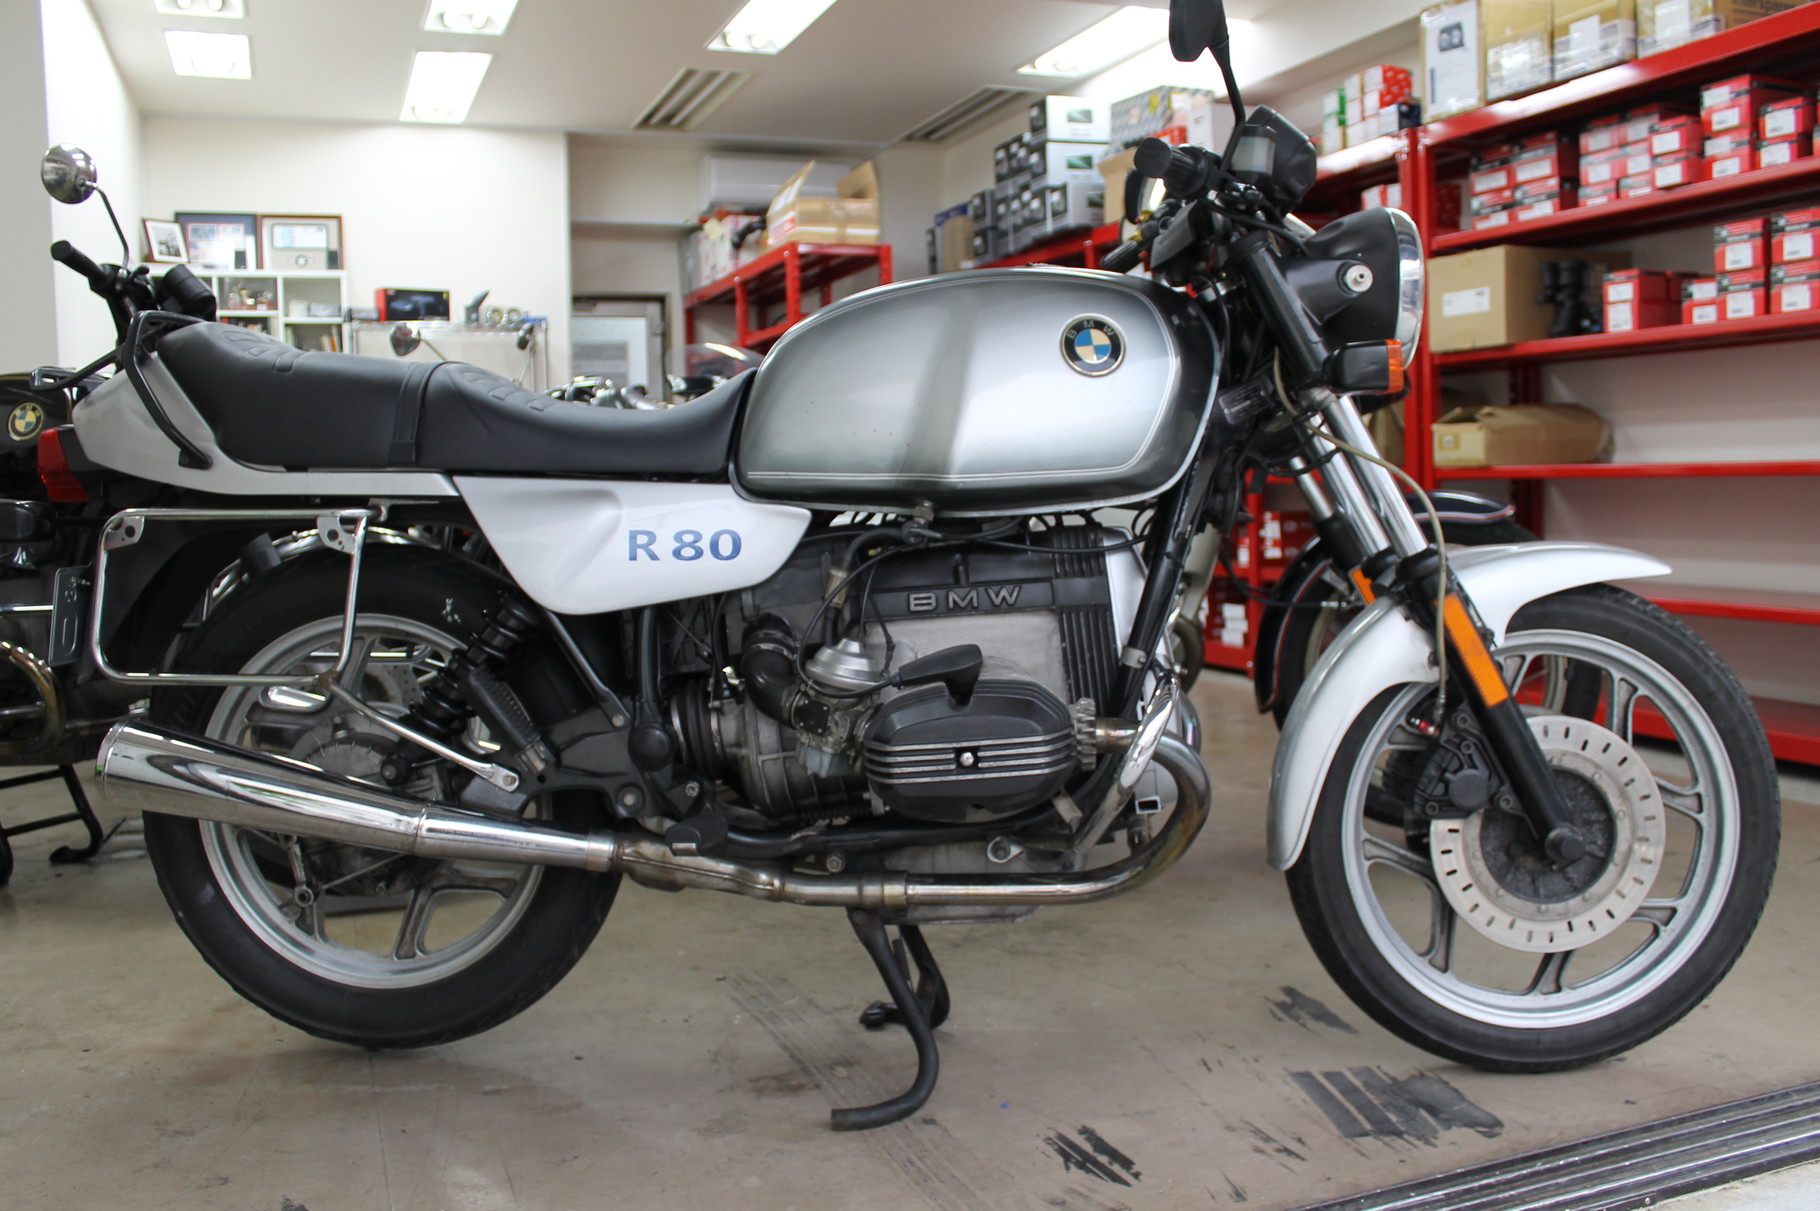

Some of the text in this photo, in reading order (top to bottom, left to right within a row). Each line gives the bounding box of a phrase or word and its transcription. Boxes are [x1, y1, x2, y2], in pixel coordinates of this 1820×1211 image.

[1066, 320, 1115, 339] BMW
[628, 528, 742, 561] R 80
[909, 585, 1021, 612] BMW
